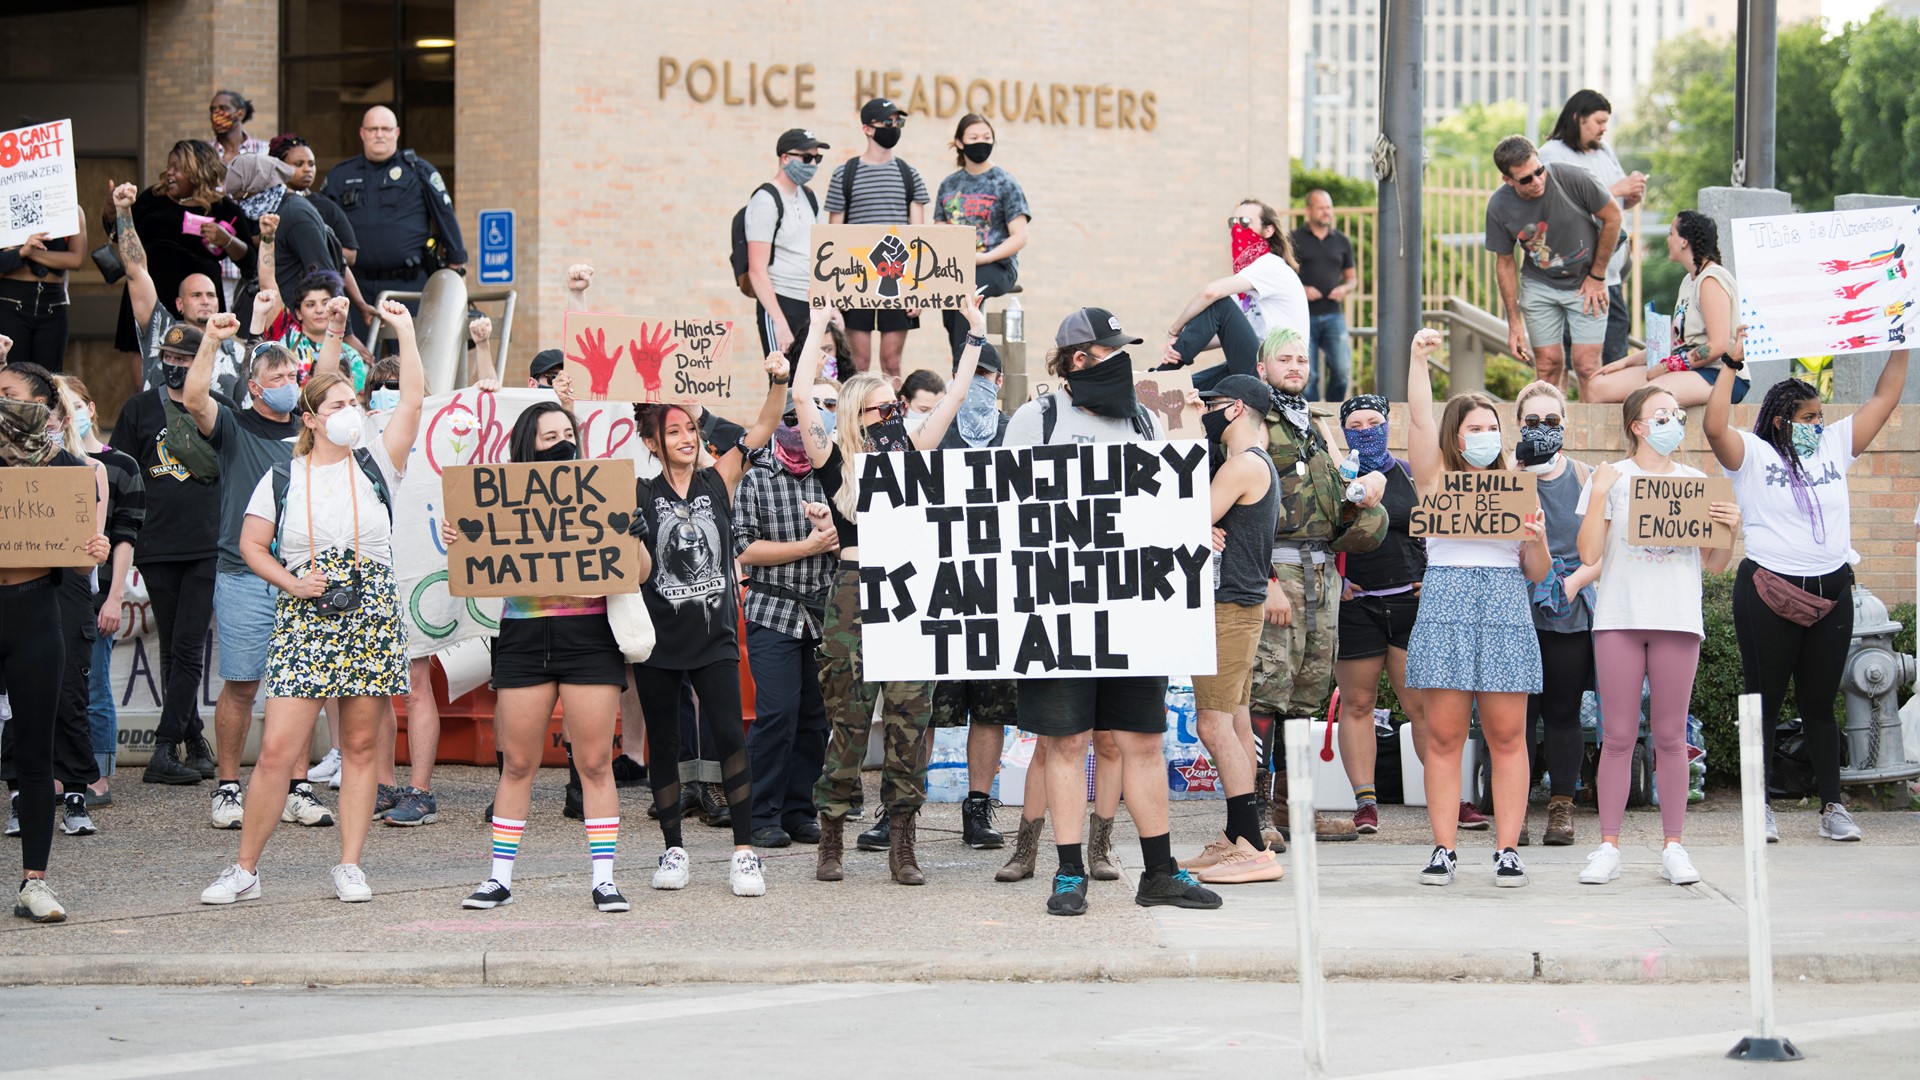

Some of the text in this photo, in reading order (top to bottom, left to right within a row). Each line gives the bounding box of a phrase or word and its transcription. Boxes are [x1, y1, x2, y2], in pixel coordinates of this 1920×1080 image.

[658, 56, 1158, 131] POLICE HEADQUARTERS
[20, 122, 63, 146] CANT
[0, 132, 20, 168] 8
[20, 139, 64, 162] WAIT
[0, 171, 38, 187] AMPAIGN
[1749, 213, 1894, 248] This is America
[485, 252, 508, 266] RAMP
[814, 241, 868, 293] Equality
[910, 236, 964, 291] Death
[860, 297, 900, 310] Lives
[904, 293, 967, 309] Matter
[674, 320, 727, 338] Hands
[690, 338, 711, 355] up
[675, 353, 713, 369] Don't
[675, 371, 731, 398] Shoot!
[25, 480, 39, 494] IS
[474, 465, 606, 507] BLACK
[857, 442, 1207, 512] AN INJURY
[1444, 473, 1524, 492] WE WILL
[1635, 479, 1705, 499] ENOUGH
[1422, 493, 1503, 511] NOT BE
[1669, 500, 1681, 516] IS
[487, 504, 604, 545] LIVES
[925, 498, 1125, 558] TO ONE
[1411, 512, 1521, 535] SILENCED
[1639, 515, 1712, 539] ENOUGH
[14, 541, 23, 551] of
[26, 541, 42, 551] the
[466, 547, 624, 584] MATTER
[664, 580, 722, 598] GET MONEY
[860, 543, 1211, 624] IS AN INJURY
[920, 610, 1128, 675] TO ALL
[117, 729, 157, 745] ODO
